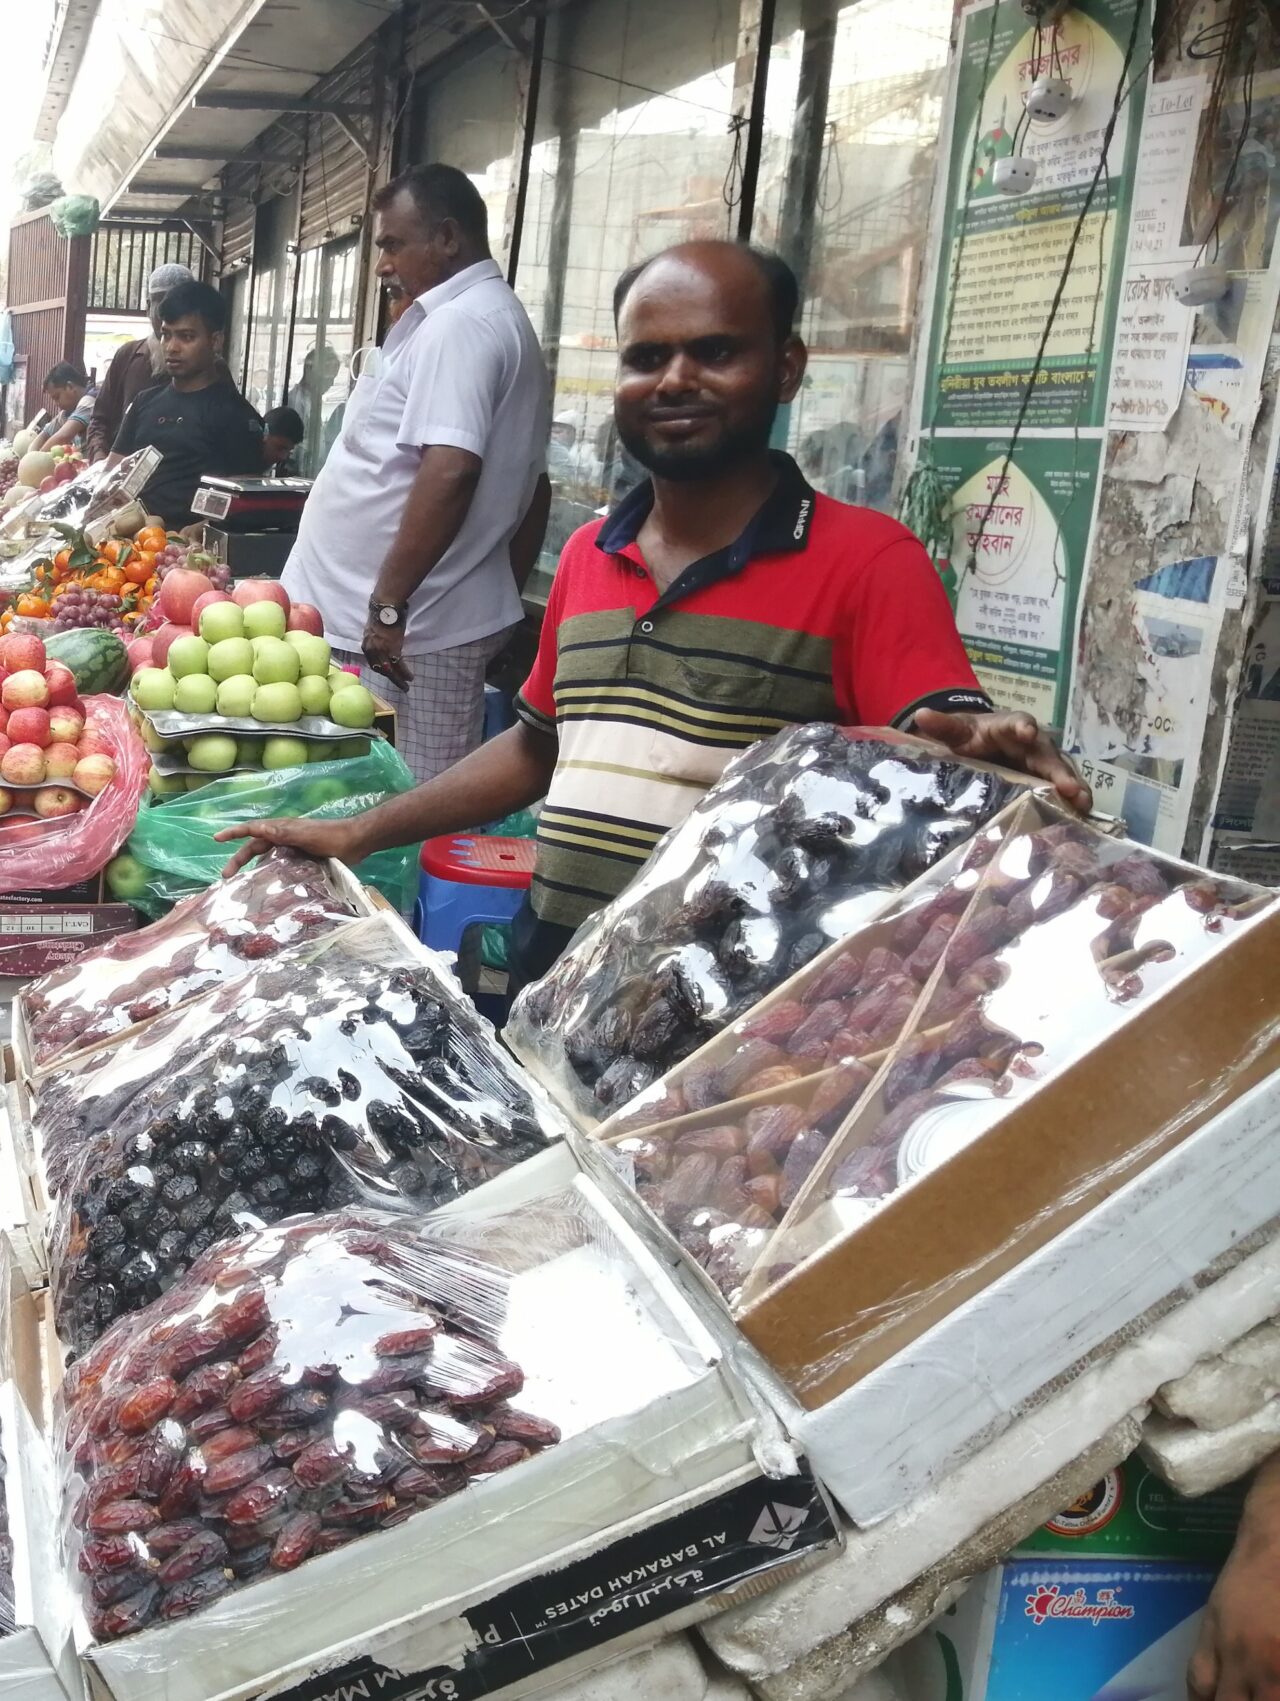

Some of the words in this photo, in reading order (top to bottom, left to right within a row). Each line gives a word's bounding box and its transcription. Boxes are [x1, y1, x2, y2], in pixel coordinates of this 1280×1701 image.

[1160, 95, 1193, 112] To-Let
[793, 499, 811, 540] GIFFINI
[36, 941, 85, 951] Christmas
[702, 1531, 727, 1549] AL
[608, 1544, 700, 1593] BARAKAH
[544, 1585, 605, 1620] DATES
[589, 1594, 635, 1627] تمور
[635, 1569, 704, 1608] البركة
[1051, 1596, 1134, 1625] Champion
